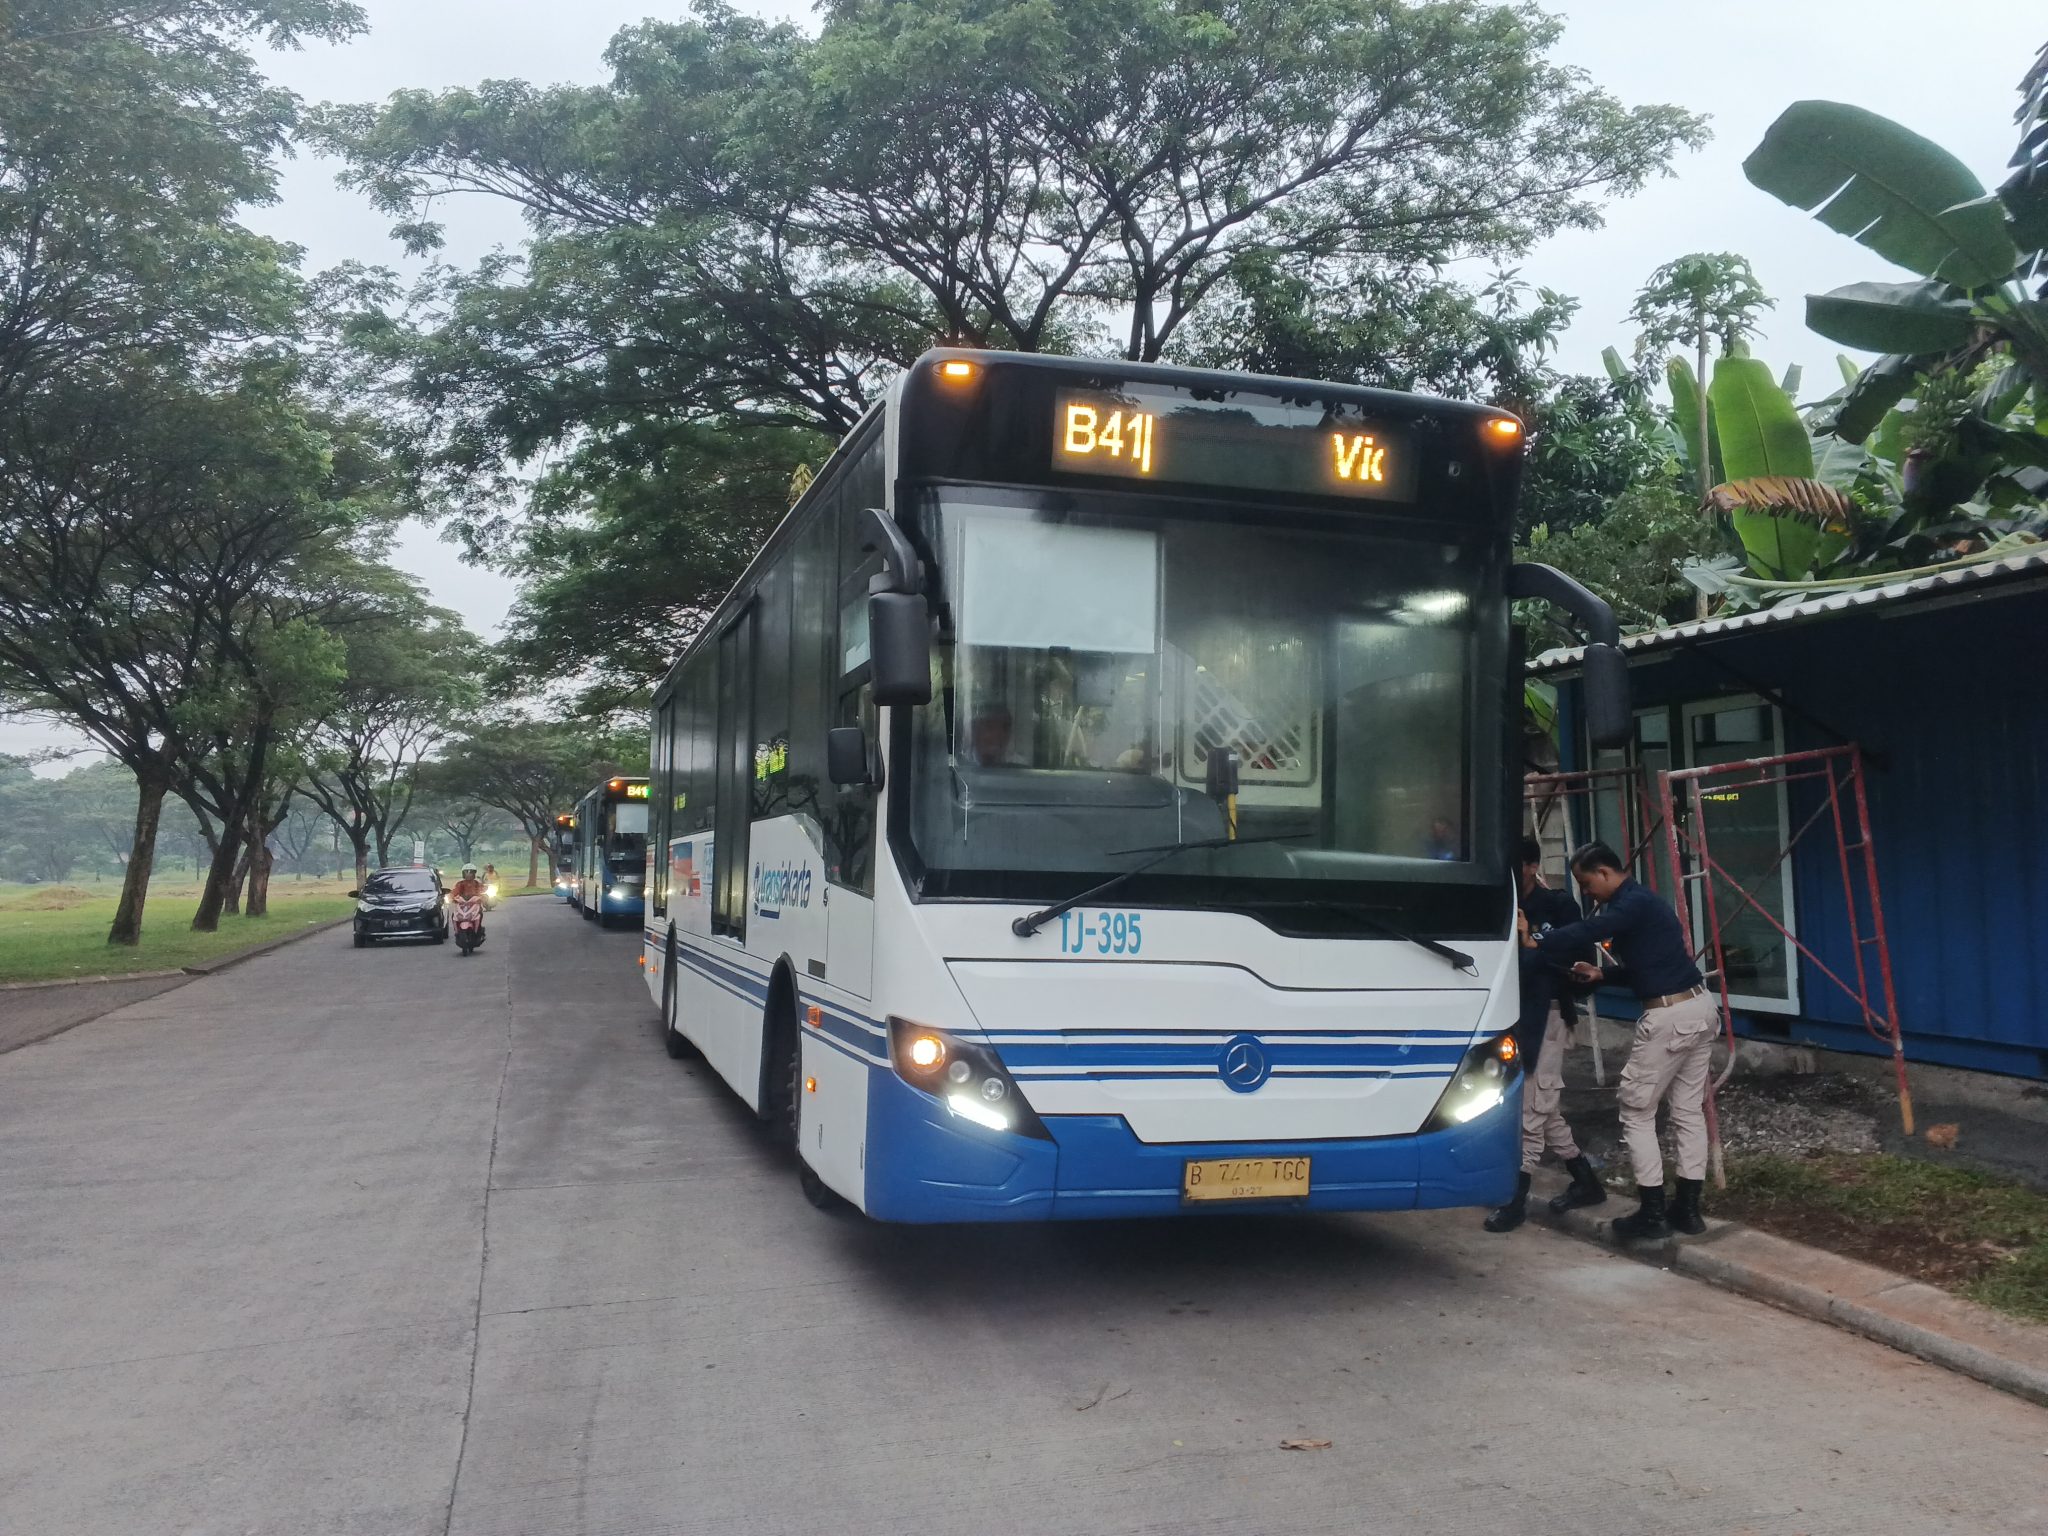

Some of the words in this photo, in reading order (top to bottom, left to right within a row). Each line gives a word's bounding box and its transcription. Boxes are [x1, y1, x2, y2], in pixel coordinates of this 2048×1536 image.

[1058, 911, 1142, 954] TJ-395
[1190, 1165, 1202, 1186] B
[1272, 1160, 1306, 1181] TGC
